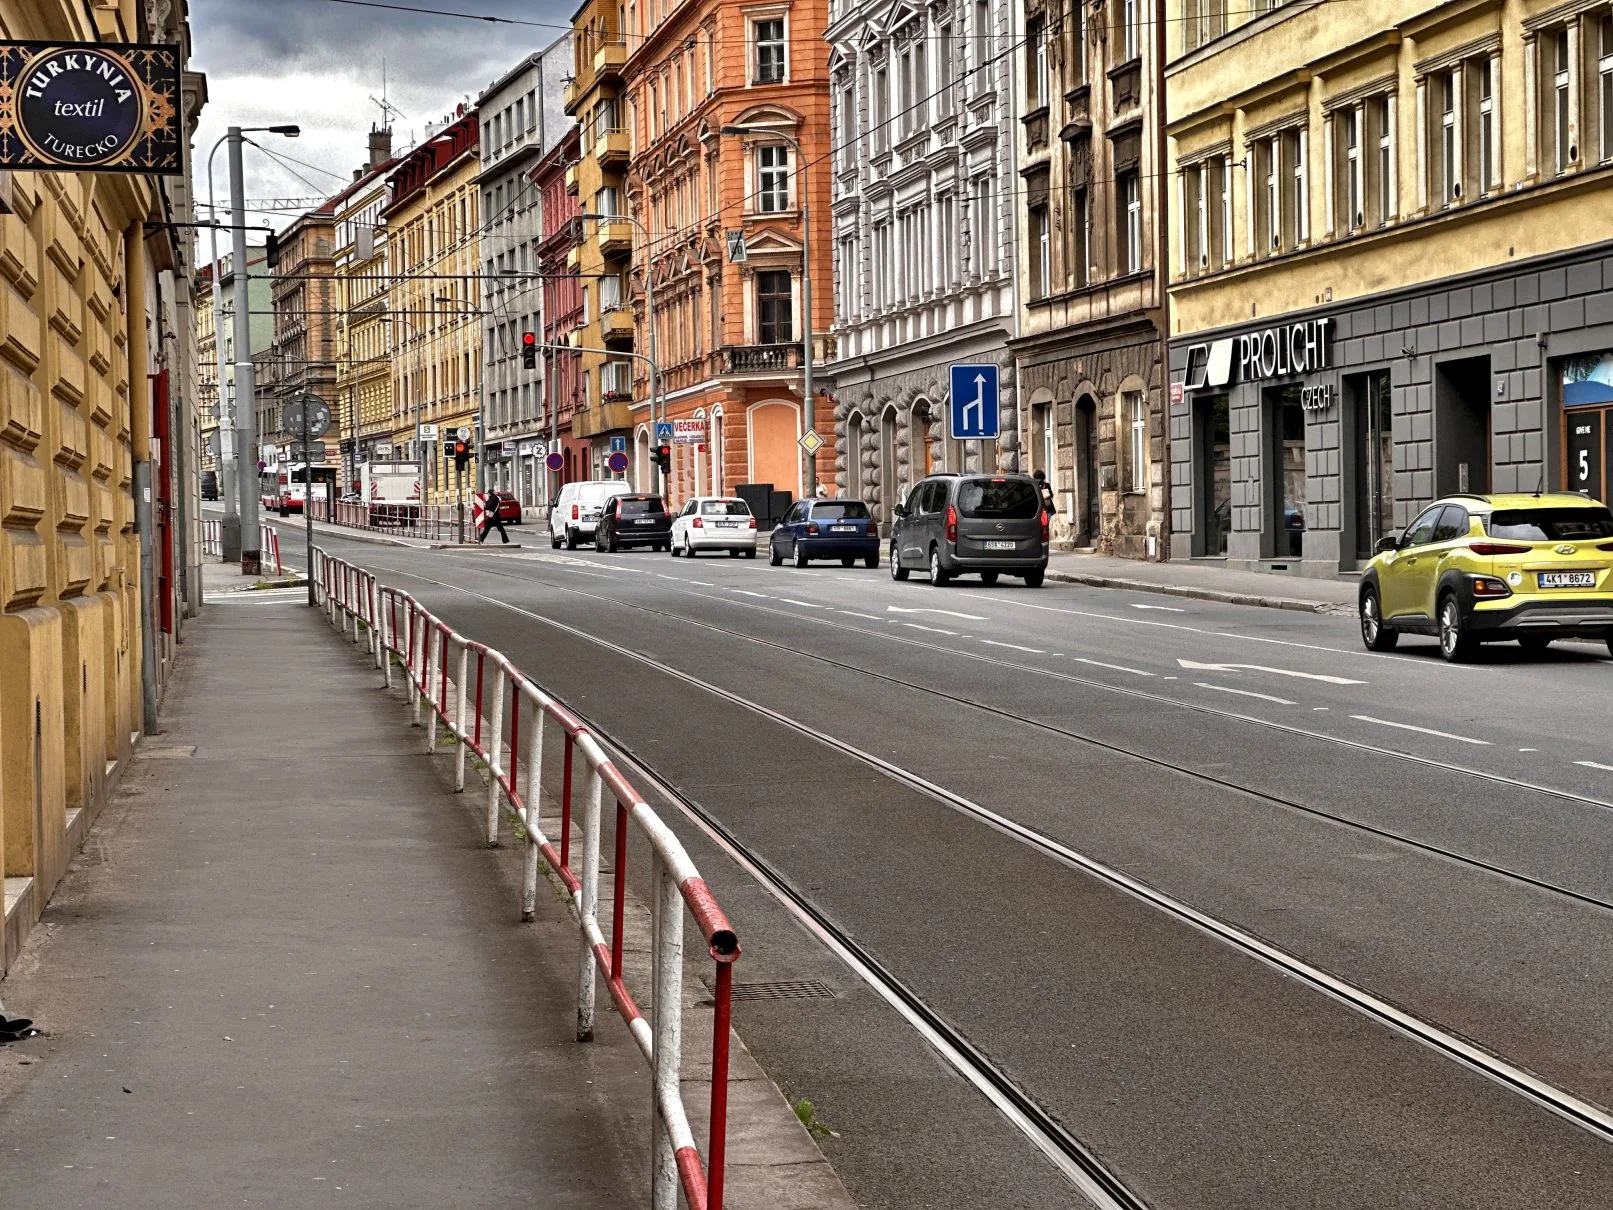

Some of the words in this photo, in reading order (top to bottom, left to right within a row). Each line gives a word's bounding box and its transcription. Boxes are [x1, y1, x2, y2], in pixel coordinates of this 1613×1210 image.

[26, 54, 132, 104] TURKYNIA
[54, 98, 104, 117] textil
[43, 132, 118, 158] TURECKO
[1240, 318, 1328, 380] PROLICHT
[1301, 384, 1330, 410] CZECH
[674, 419, 705, 432] VEČERKA
[1579, 449, 1589, 481] 5
[1546, 573, 1563, 584] 4K1
[1568, 573, 1591, 583] 8672
